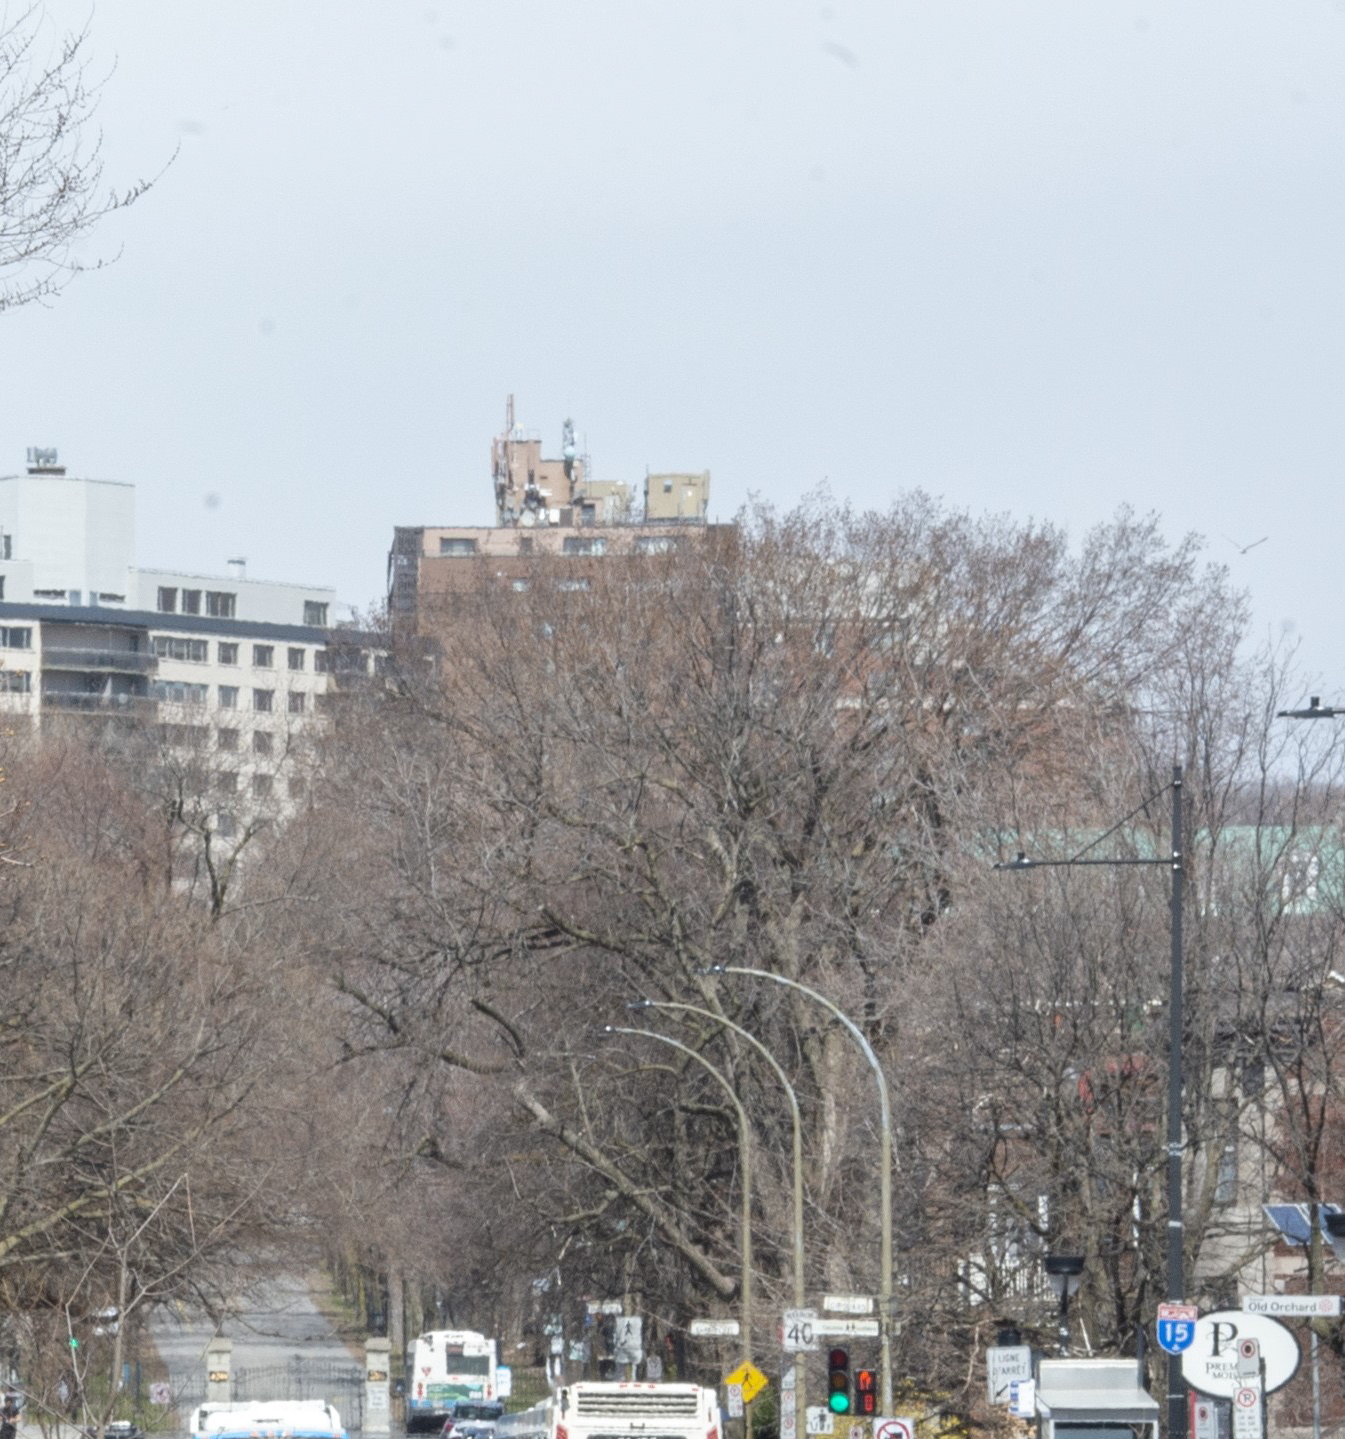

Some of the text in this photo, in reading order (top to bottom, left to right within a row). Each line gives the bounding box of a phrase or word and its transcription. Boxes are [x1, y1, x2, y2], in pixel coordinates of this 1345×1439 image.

[1248, 1301, 1317, 1313] Old Orchard
[787, 1322, 813, 1345] 40
[1165, 1322, 1189, 1343] 15
[998, 1353, 1020, 1362] LIGNE
